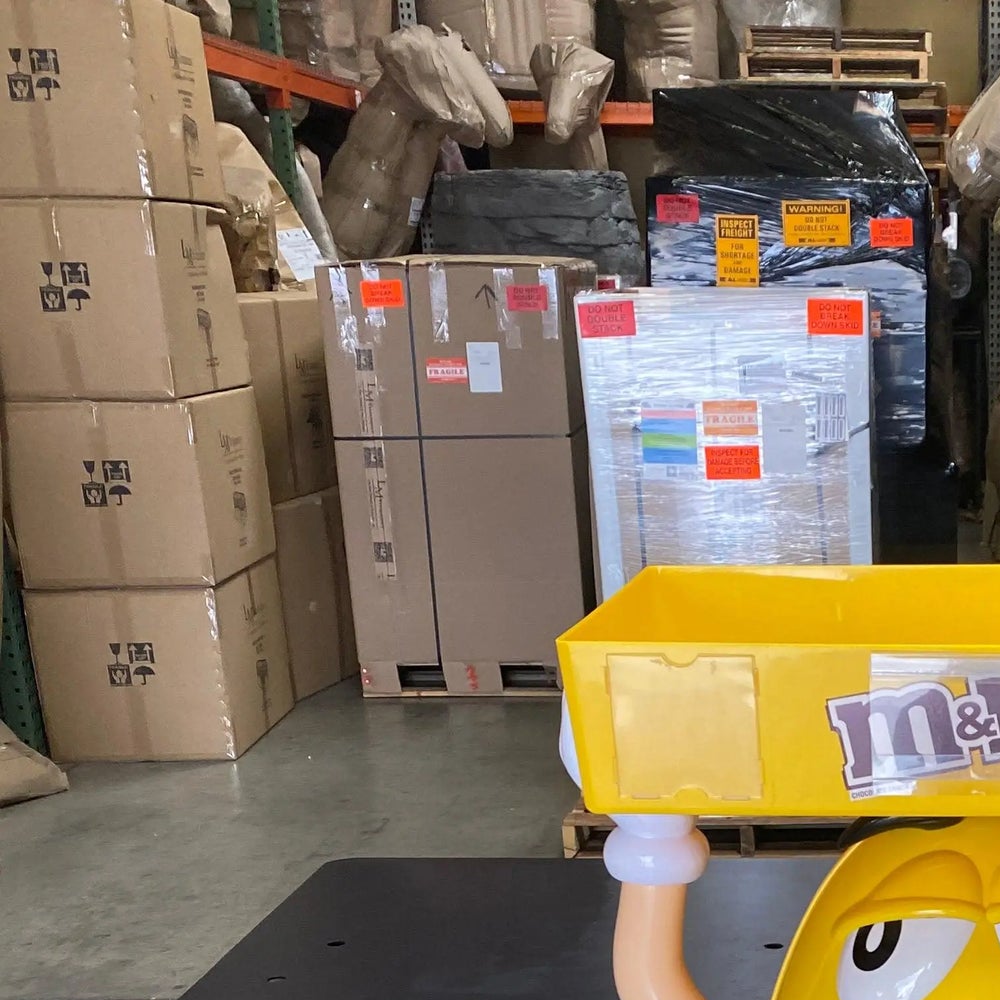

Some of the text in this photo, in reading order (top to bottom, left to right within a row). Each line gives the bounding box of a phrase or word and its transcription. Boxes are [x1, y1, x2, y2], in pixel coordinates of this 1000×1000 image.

[788, 205, 843, 213] WARNING!
[720, 219, 753, 228] INSPECT
[793, 224, 840, 232] DOUBLE STACK
[720, 228, 754, 238] FREIGHT
[731, 243, 744, 251] FOR
[588, 304, 623, 314] DO NOT
[819, 303, 852, 312] DO NOT
[587, 314, 627, 324] DOUBLE
[820, 312, 849, 320] BREAK
[591, 325, 623, 334] STACK
[811, 321, 838, 329] DOWN
